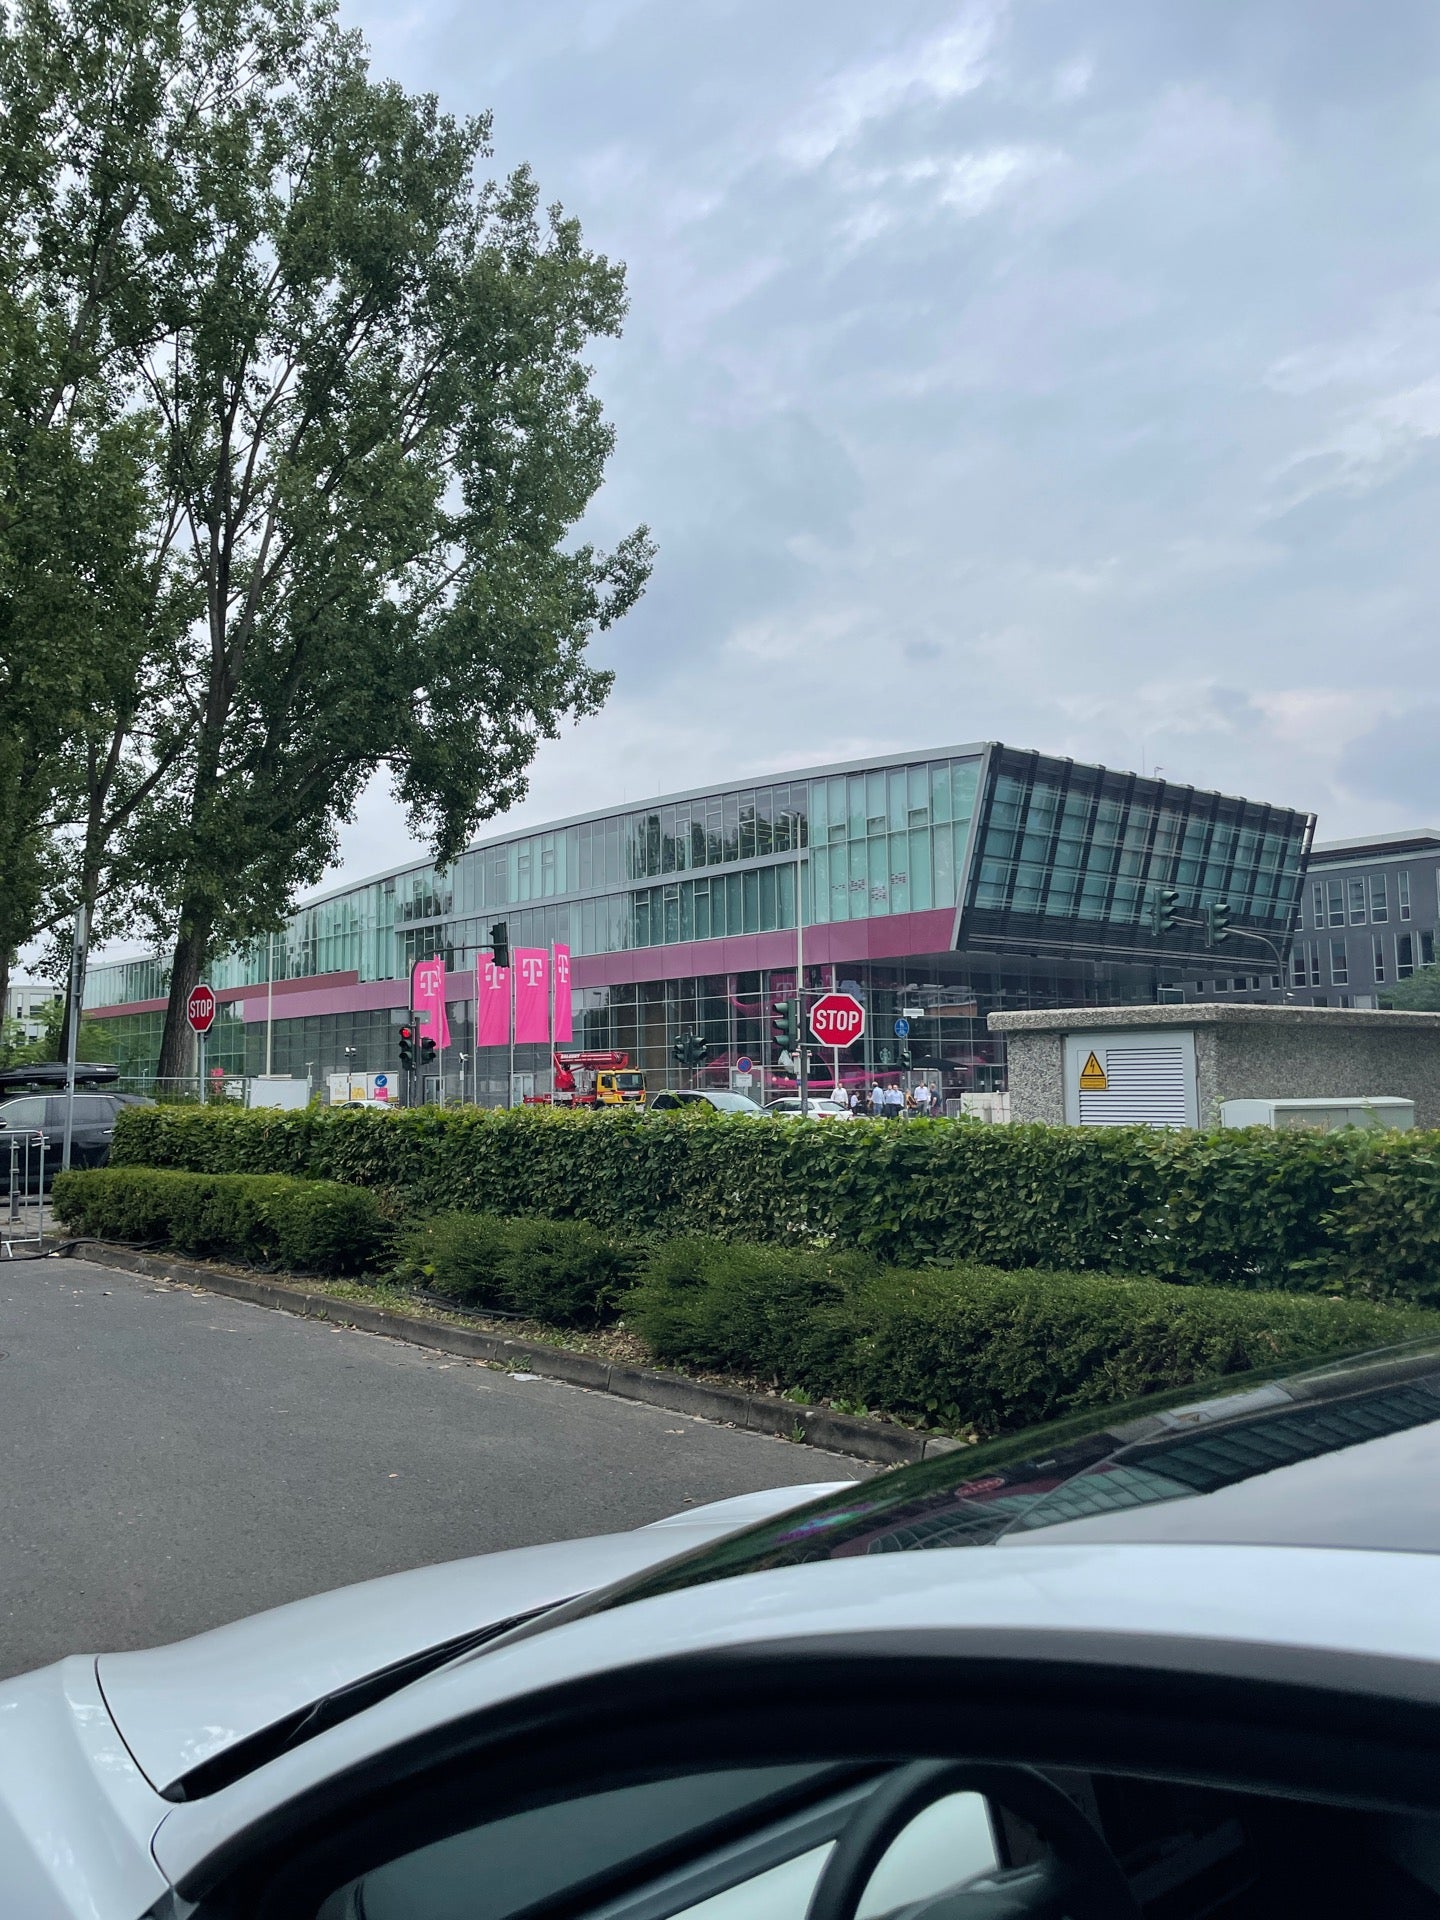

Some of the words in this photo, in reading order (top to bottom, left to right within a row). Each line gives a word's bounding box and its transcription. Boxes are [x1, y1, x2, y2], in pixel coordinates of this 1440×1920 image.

[522, 958, 543, 987] T
[558, 954, 569, 983] T
[420, 970, 438, 997] T
[190, 999, 212, 1018] STOP
[815, 1009, 860, 1031] STOP
